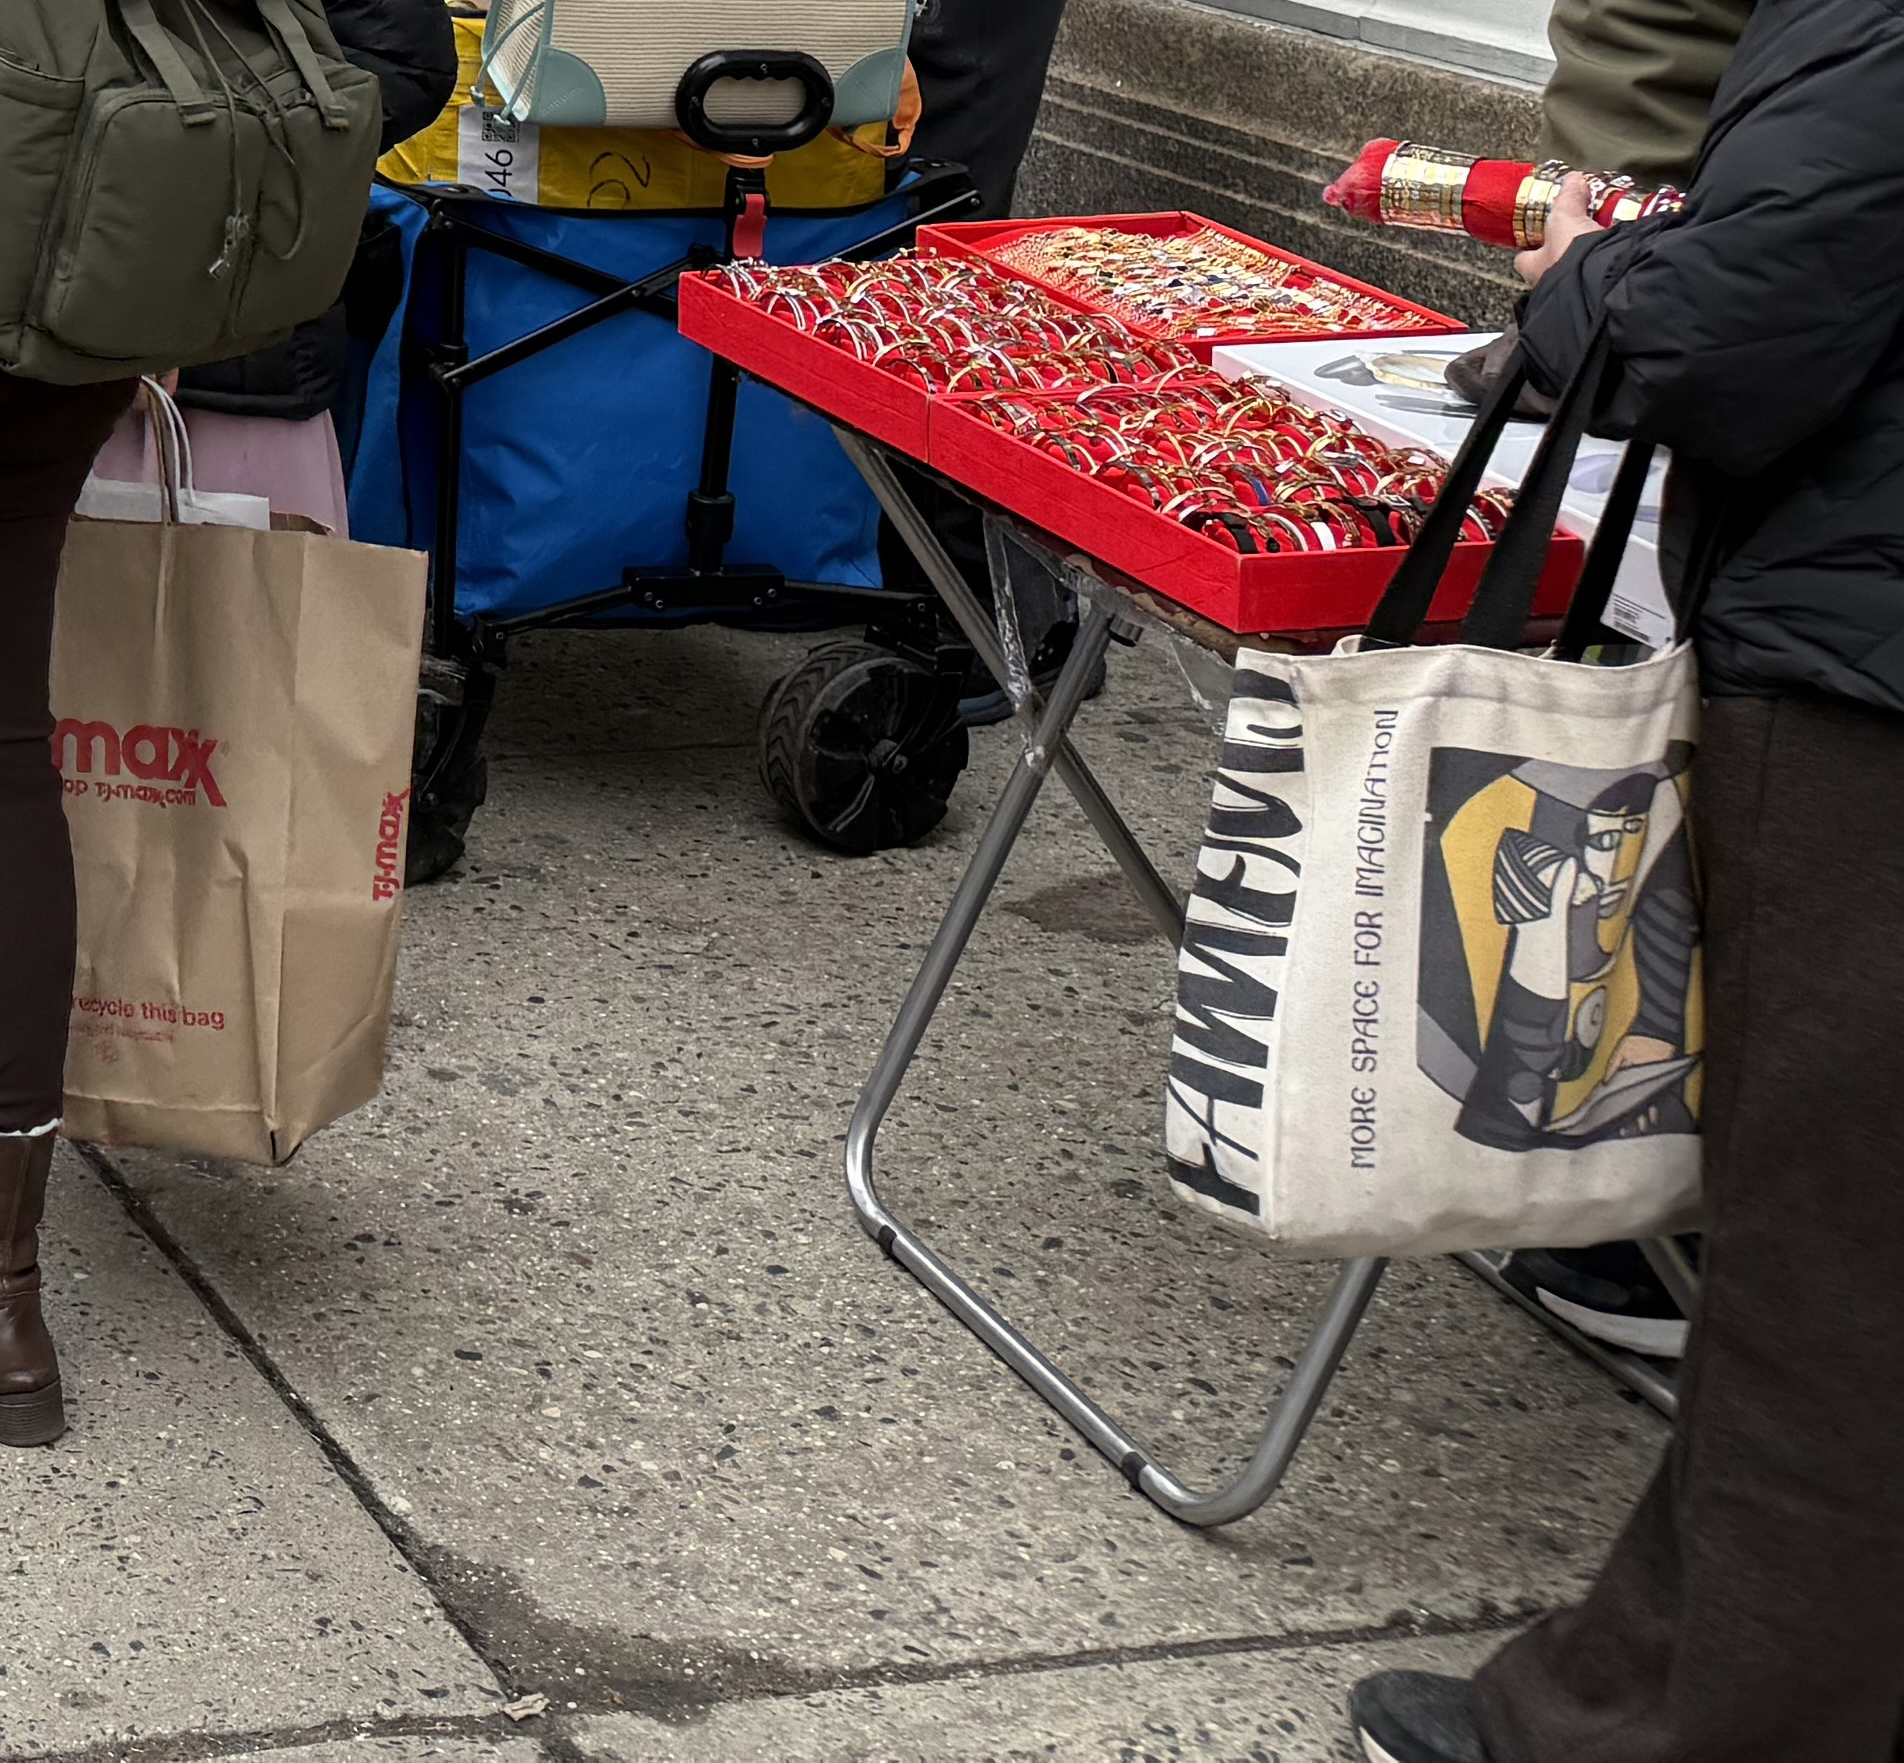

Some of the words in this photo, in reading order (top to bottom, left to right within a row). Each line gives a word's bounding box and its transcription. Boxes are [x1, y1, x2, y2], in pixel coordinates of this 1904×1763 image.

[1354, 709, 1399, 897] IMAGINATION
[1353, 911, 1383, 966] FOR
[141, 1002, 177, 1024] this
[182, 1005, 225, 1031] bag
[1350, 979, 1381, 1073] SPACE
[1349, 1088, 1377, 1169] MORE
